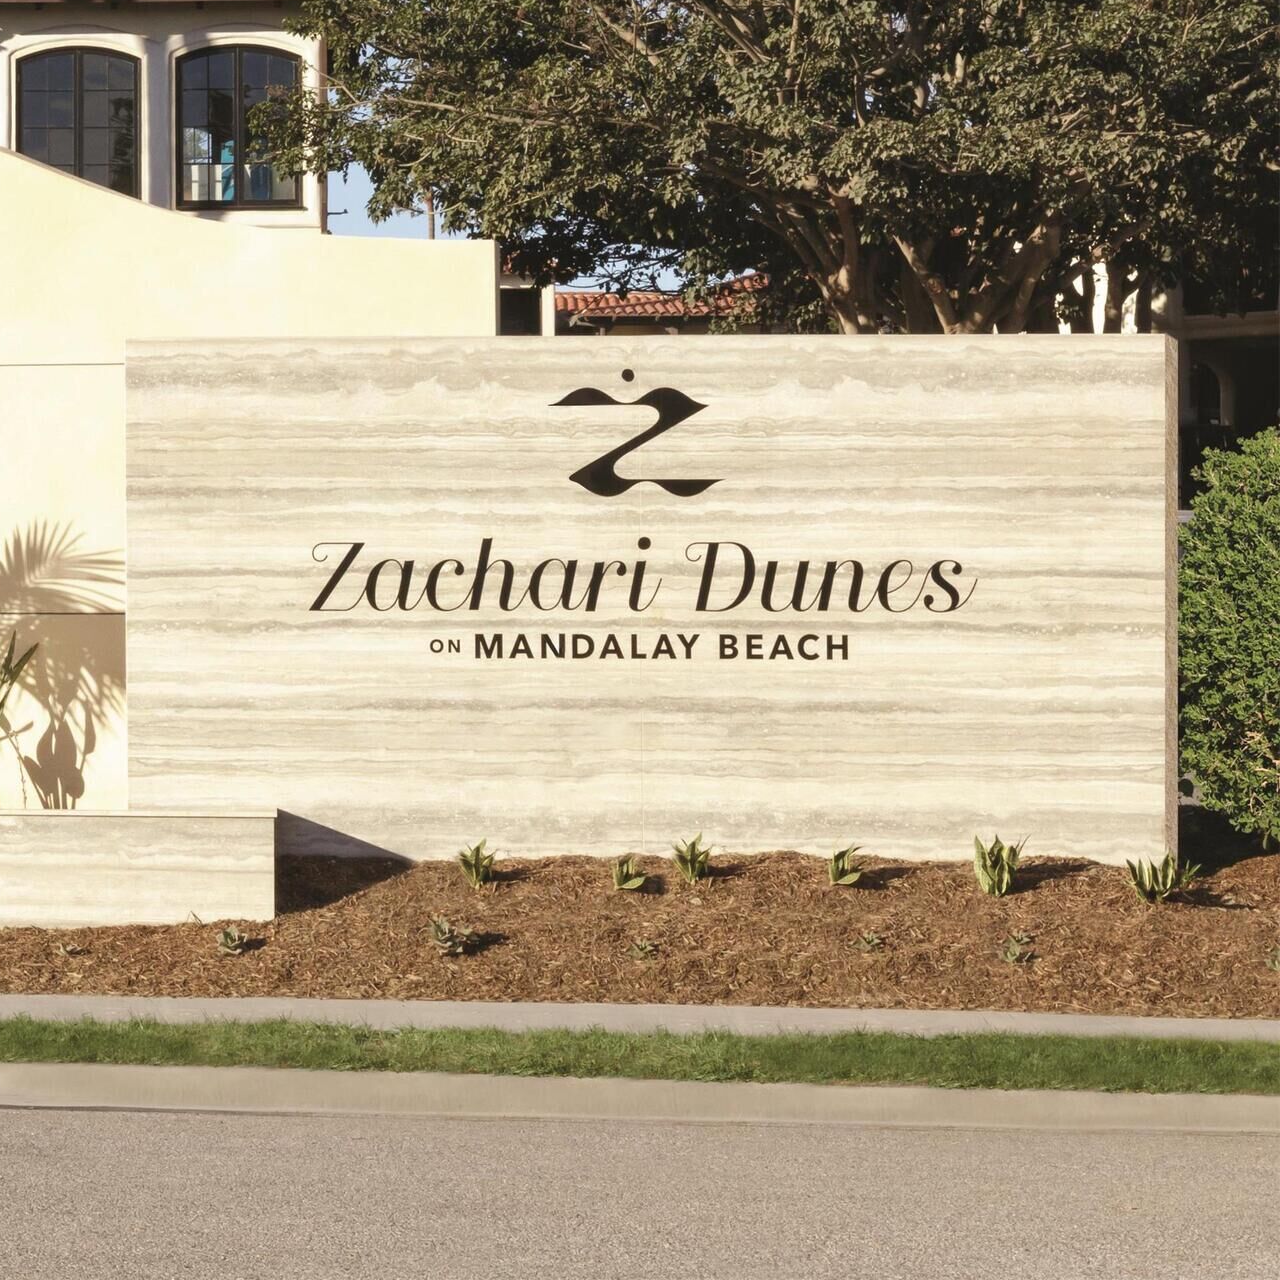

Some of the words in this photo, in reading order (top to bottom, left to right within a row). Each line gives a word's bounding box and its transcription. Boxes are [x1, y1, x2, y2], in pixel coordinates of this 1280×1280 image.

[309, 536, 662, 613] Zachari
[685, 541, 978, 613] Dunes
[429, 638, 461, 654] ON
[474, 632, 701, 660] MANDALAY
[718, 633, 849, 661] BEACH
